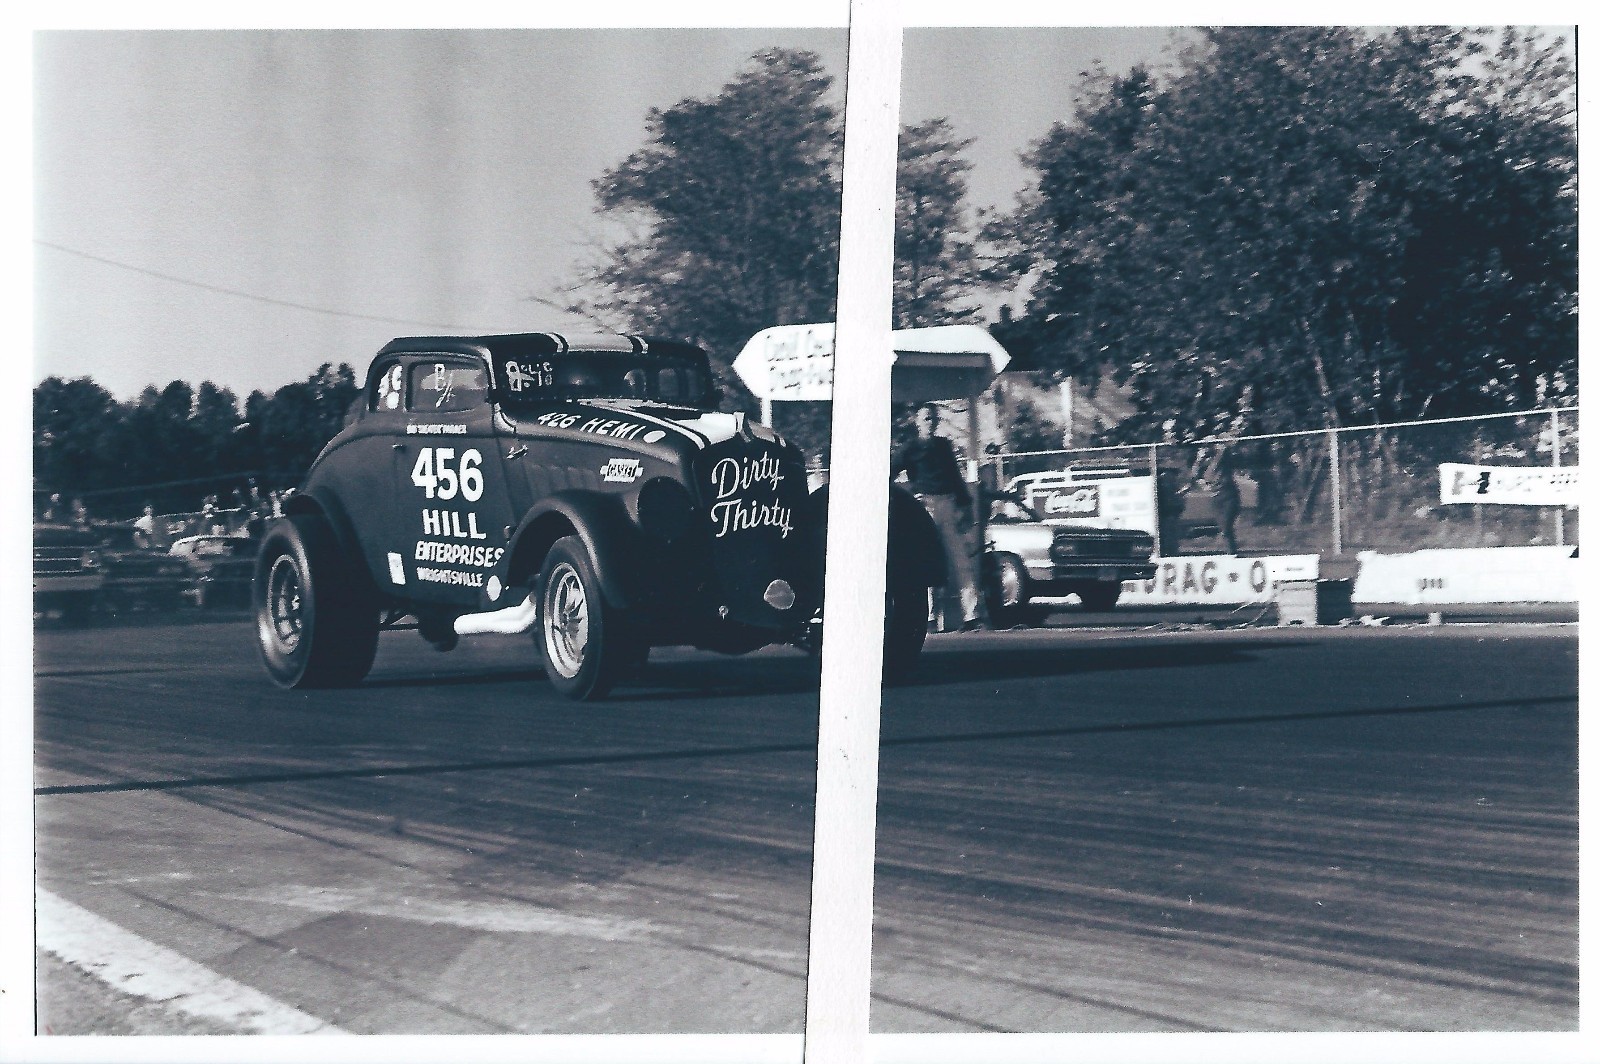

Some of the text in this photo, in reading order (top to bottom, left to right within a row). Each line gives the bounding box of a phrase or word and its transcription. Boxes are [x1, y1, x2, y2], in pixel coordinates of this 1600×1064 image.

[538, 412, 647, 441] 426 HEMI
[411, 447, 484, 502] 456
[711, 451, 785, 499] Dirty
[422, 508, 487, 540] HILL
[710, 498, 794, 539] Thirty
[415, 541, 505, 568] ENTERPRISES
